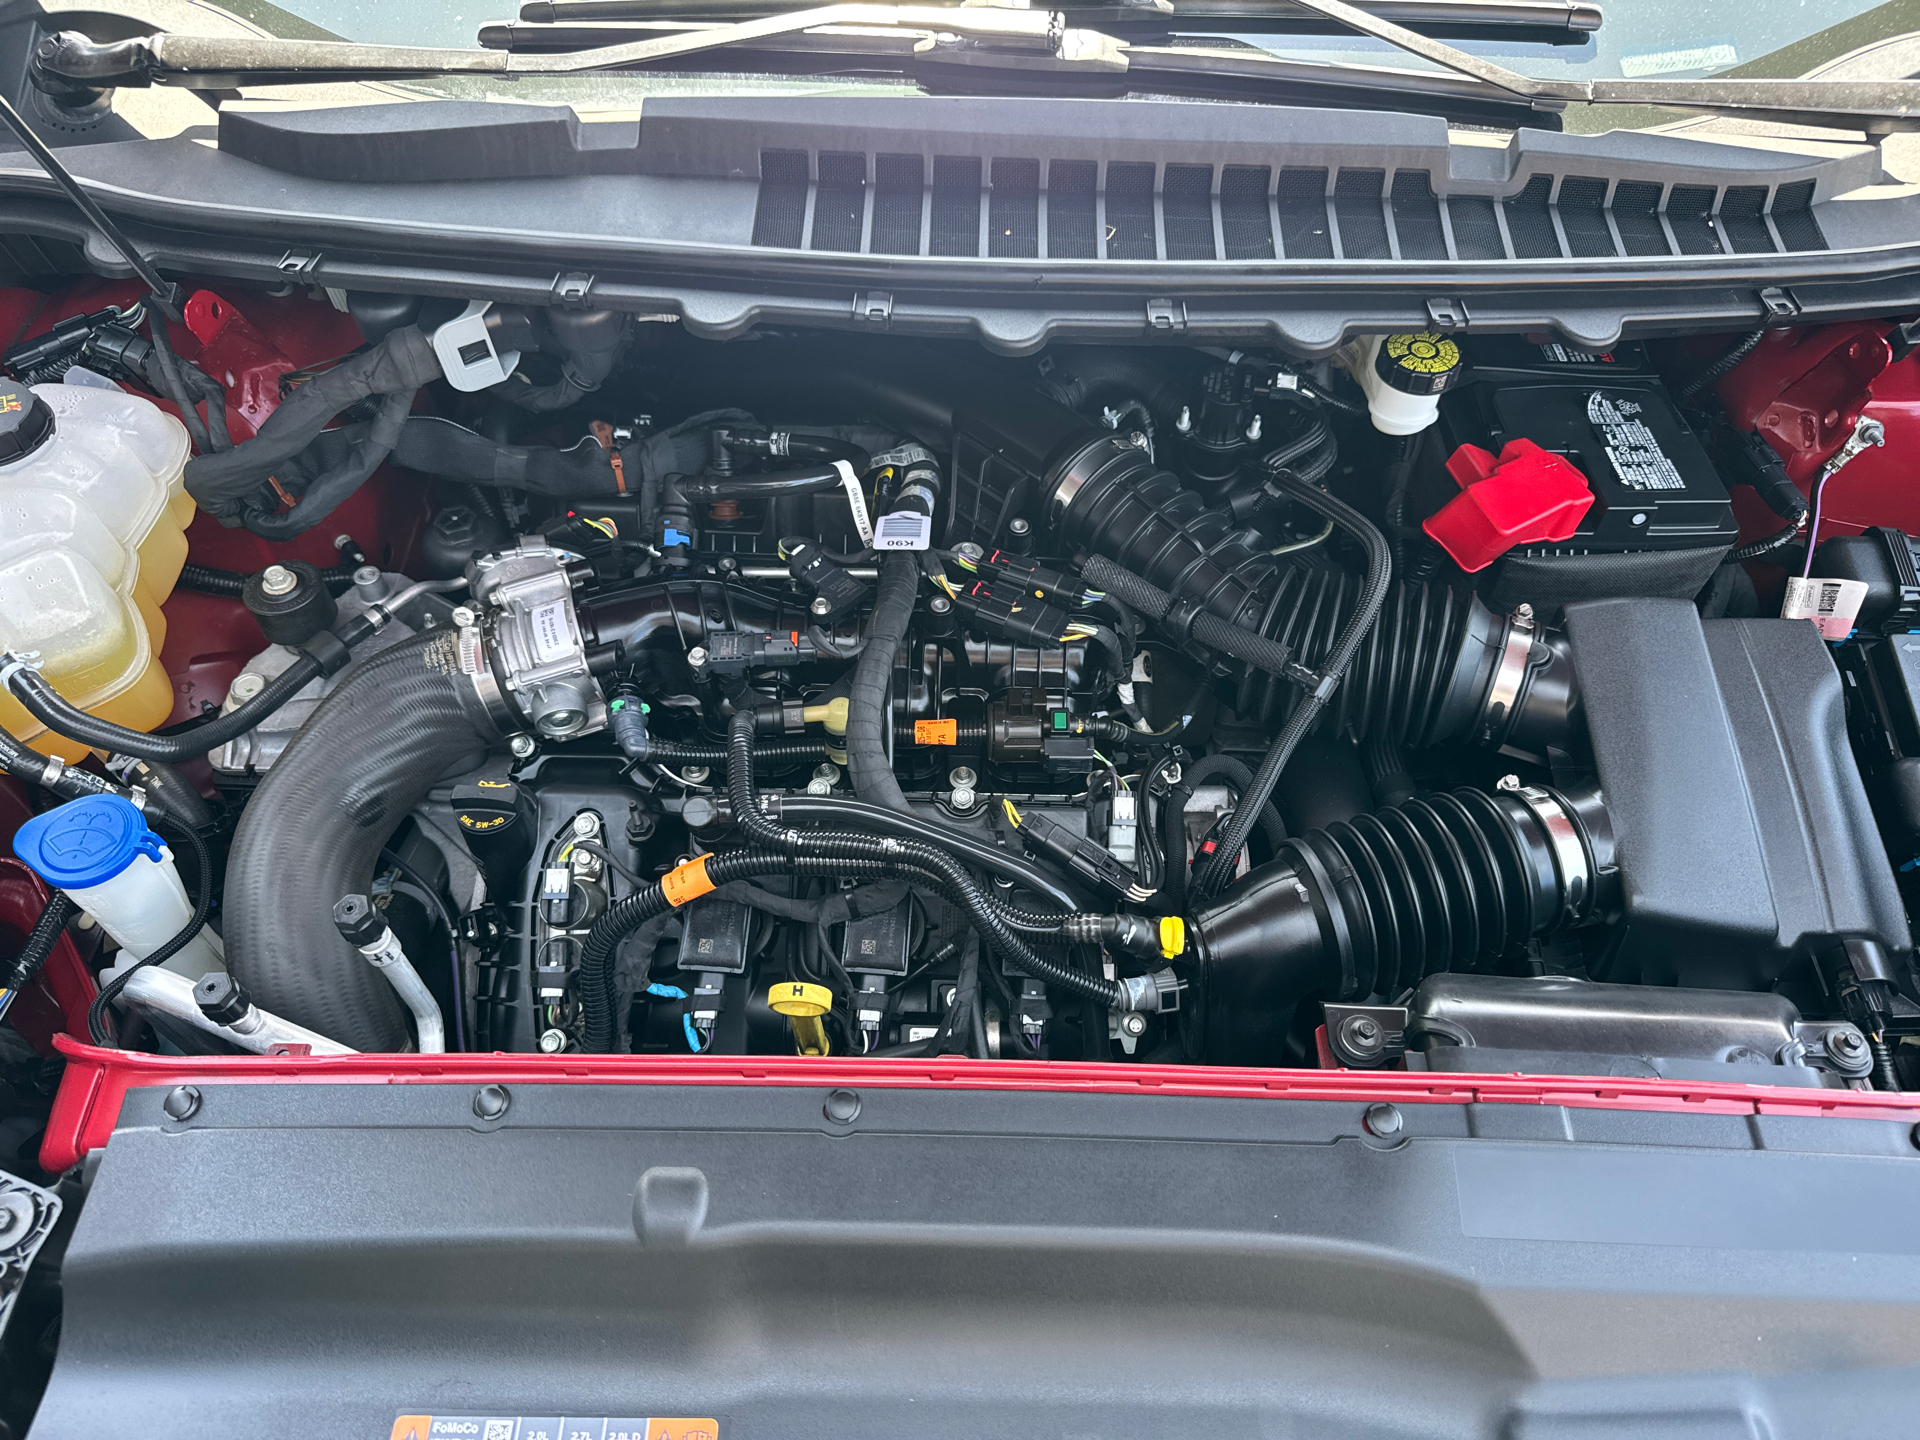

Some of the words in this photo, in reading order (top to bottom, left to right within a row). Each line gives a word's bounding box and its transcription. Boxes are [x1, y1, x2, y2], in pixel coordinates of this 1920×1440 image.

[460, 815, 474, 827] SAE
[475, 817, 505, 829] 5W-30
[792, 984, 804, 997] H
[432, 1421, 479, 1434] FoMoCo
[526, 1430, 549, 1440] 2.0L
[570, 1431, 592, 1440] 2.7L
[608, 1432, 630, 1440] 2.0L
[632, 1432, 641, 1440] D
